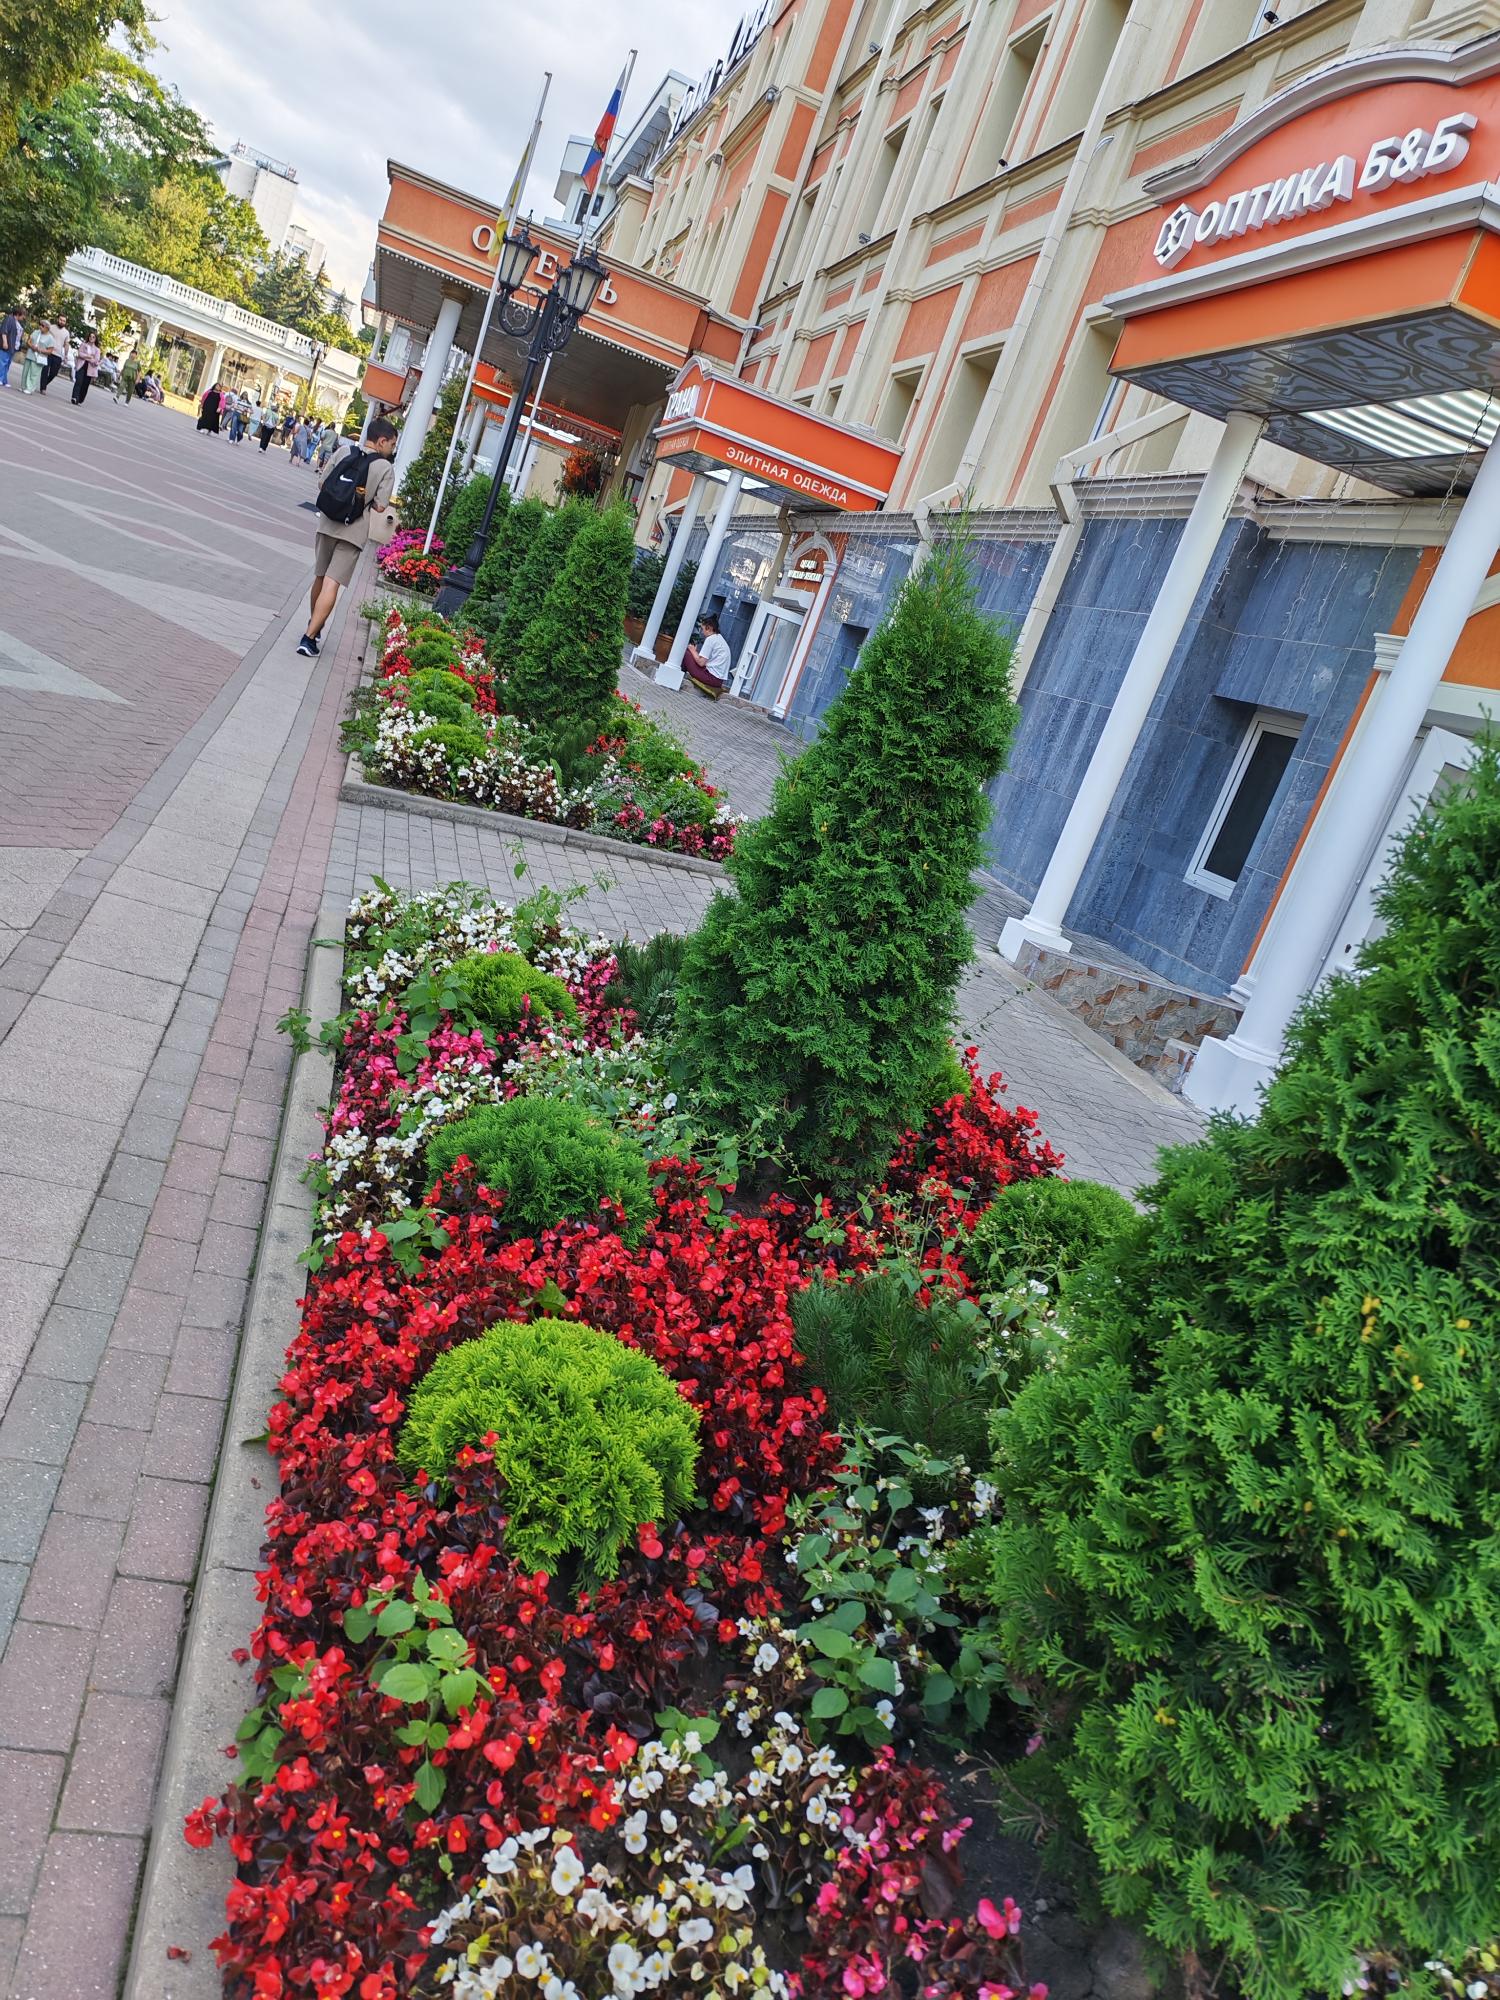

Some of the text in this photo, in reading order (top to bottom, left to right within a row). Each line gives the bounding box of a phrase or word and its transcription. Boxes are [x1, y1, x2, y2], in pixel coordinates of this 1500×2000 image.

[1194, 112, 1479, 247] ОПТИКА Б&Б
[472, 224, 617, 305] ОЕЬ
[726, 446, 848, 504] ЭЛИТНАЯ ОДЕЖДА
